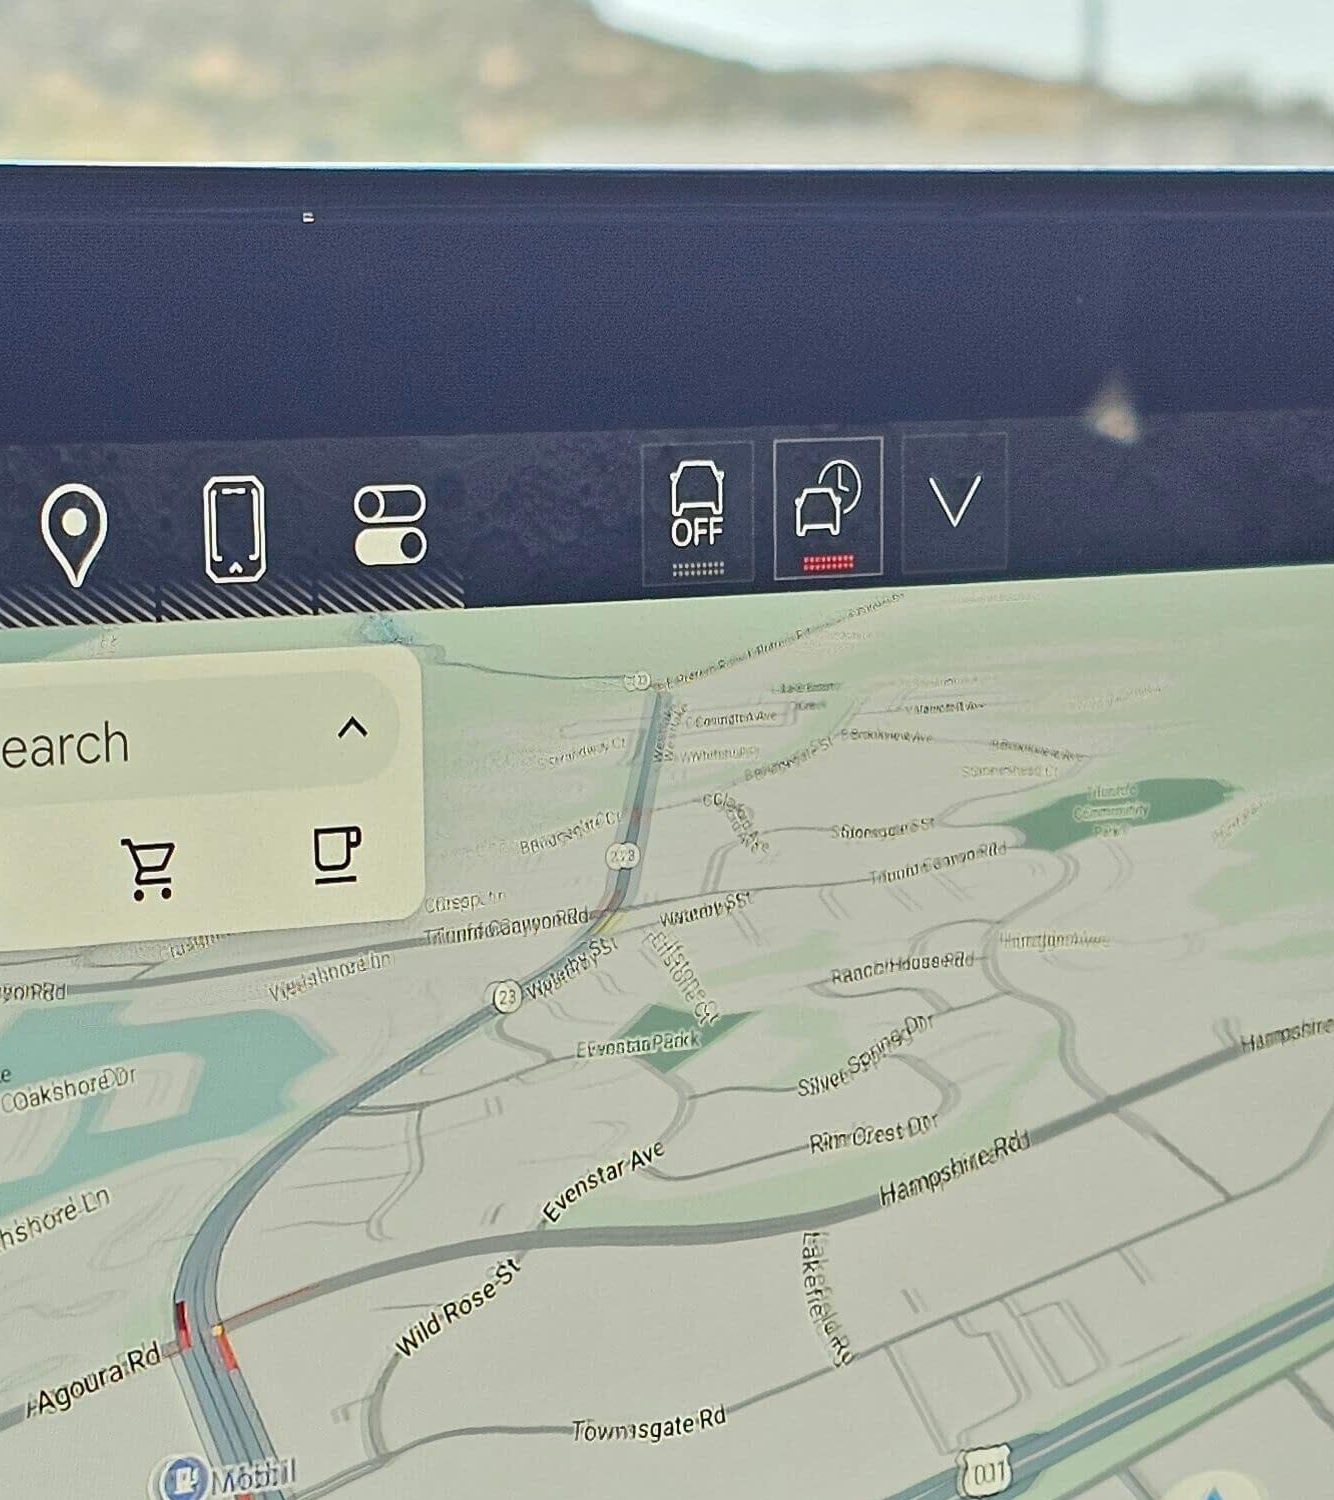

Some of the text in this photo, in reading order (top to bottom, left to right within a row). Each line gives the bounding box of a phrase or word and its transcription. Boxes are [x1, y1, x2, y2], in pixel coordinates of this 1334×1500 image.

[671, 516, 724, 548] OFF
[1, 1065, 138, 1114] Oakshore Dr
[541, 1139, 667, 1225] Evenstar Ave
[878, 1128, 1032, 1208] Hampshire Rd
[80, 1186, 111, 1215] Ln
[394, 1256, 523, 1361] Wild Rose St
[28, 1338, 163, 1418] Agoura Rd
[571, 1404, 728, 1445] Townsgate Rd
